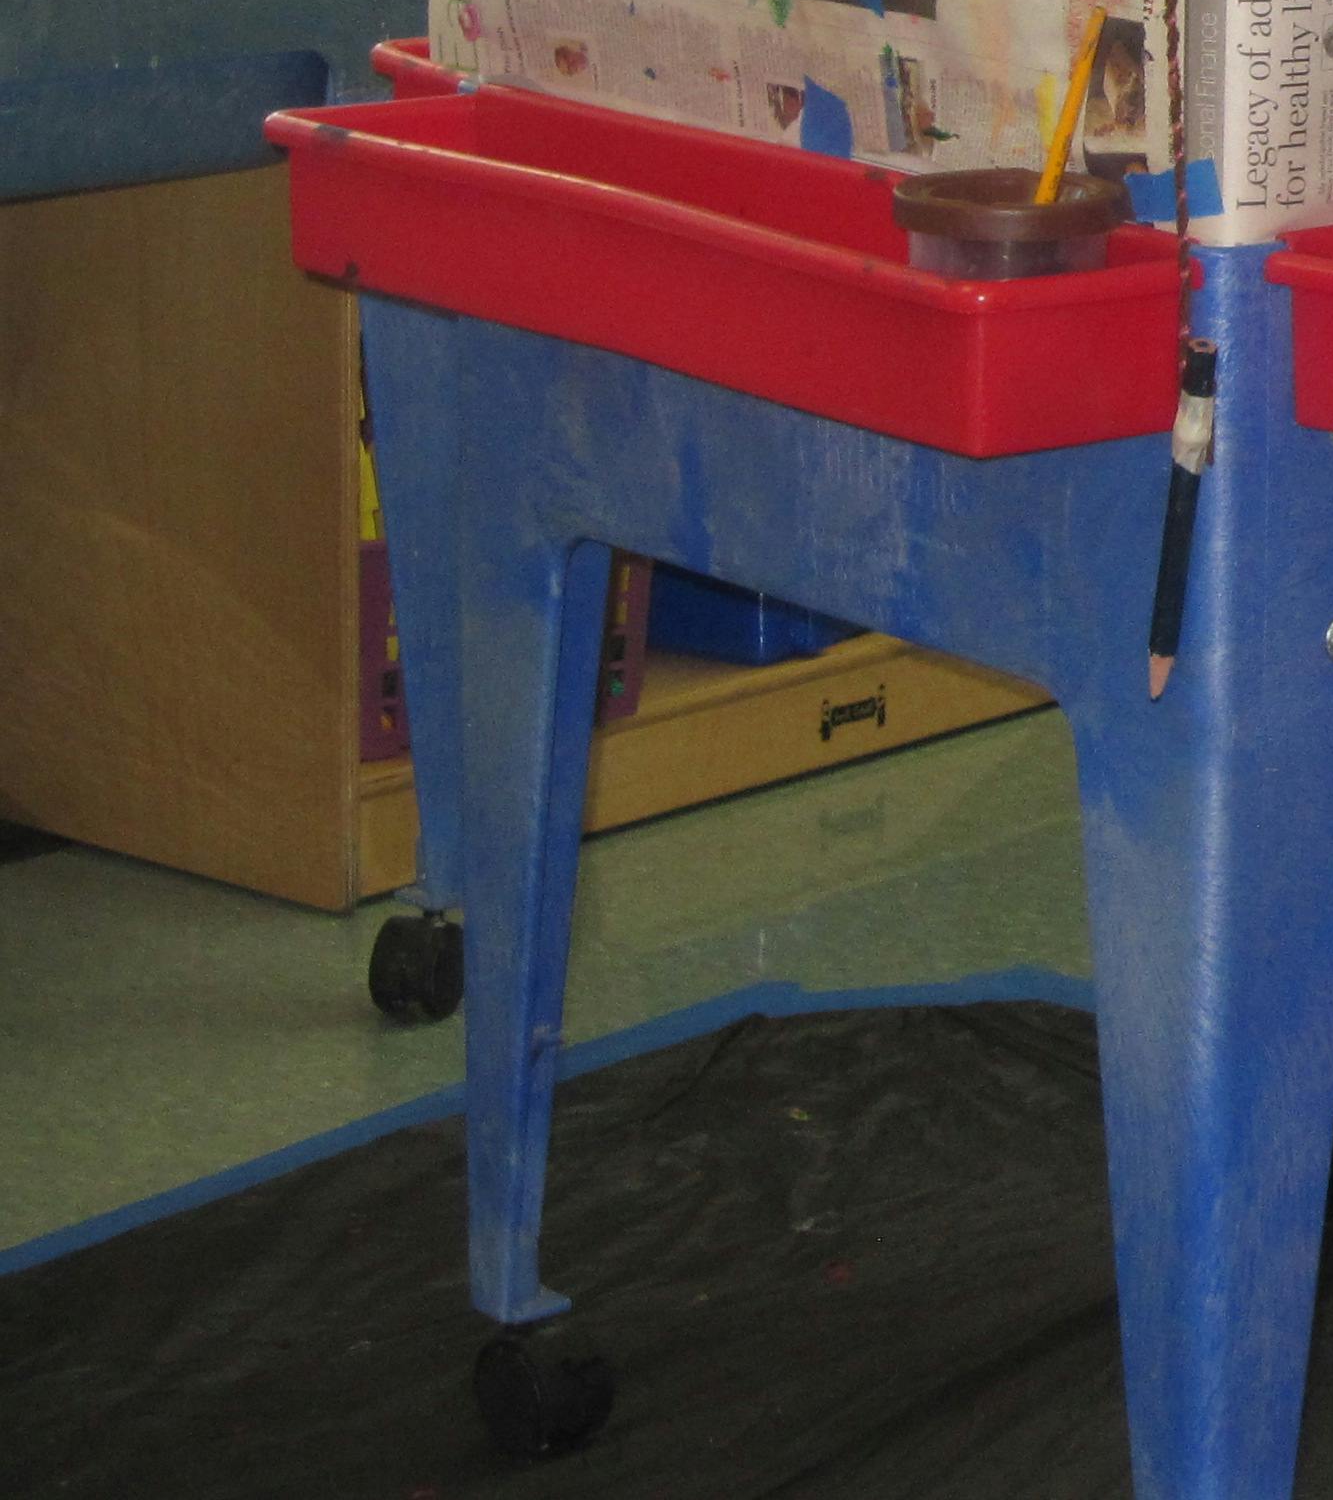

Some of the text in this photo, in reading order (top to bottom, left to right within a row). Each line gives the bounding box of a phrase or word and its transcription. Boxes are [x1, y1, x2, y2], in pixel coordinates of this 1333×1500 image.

[1195, 12, 1218, 160] sonal Finance
[1237, 44, 1271, 81] of
[1277, 24, 1320, 150] healthy
[1236, 91, 1277, 210] Legacy
[1276, 160, 1307, 210] for
